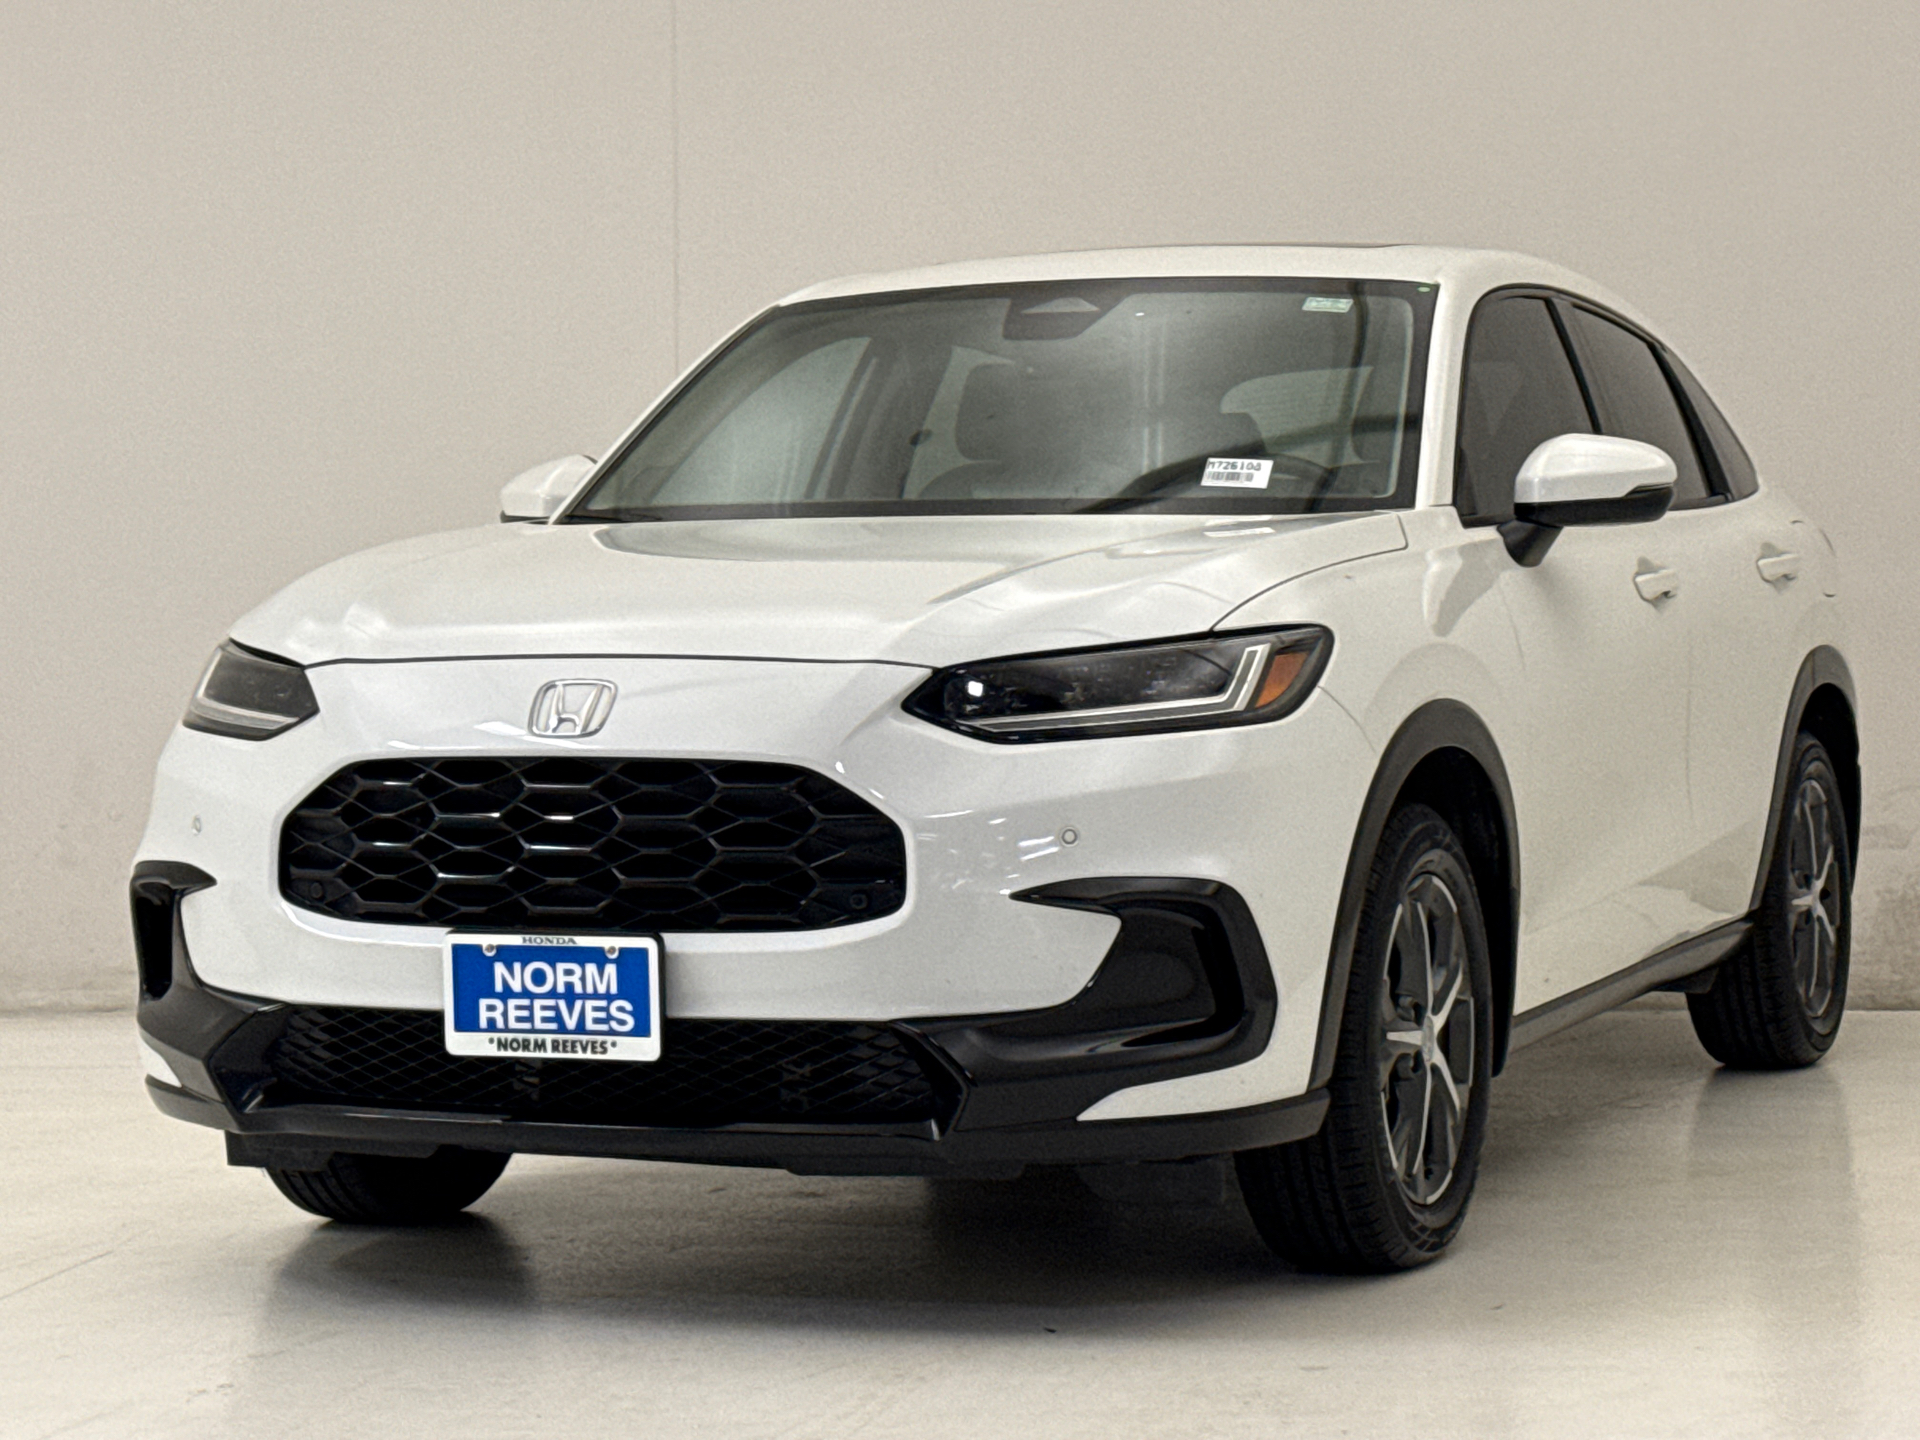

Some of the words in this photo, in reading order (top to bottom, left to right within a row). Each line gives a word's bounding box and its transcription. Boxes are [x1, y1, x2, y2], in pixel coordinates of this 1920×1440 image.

[522, 936, 577, 945] HONDA
[493, 961, 618, 995] NORM
[478, 998, 635, 1032] REEVES
[496, 1037, 548, 1053] NORM
[551, 1038, 608, 1055] REEVES
